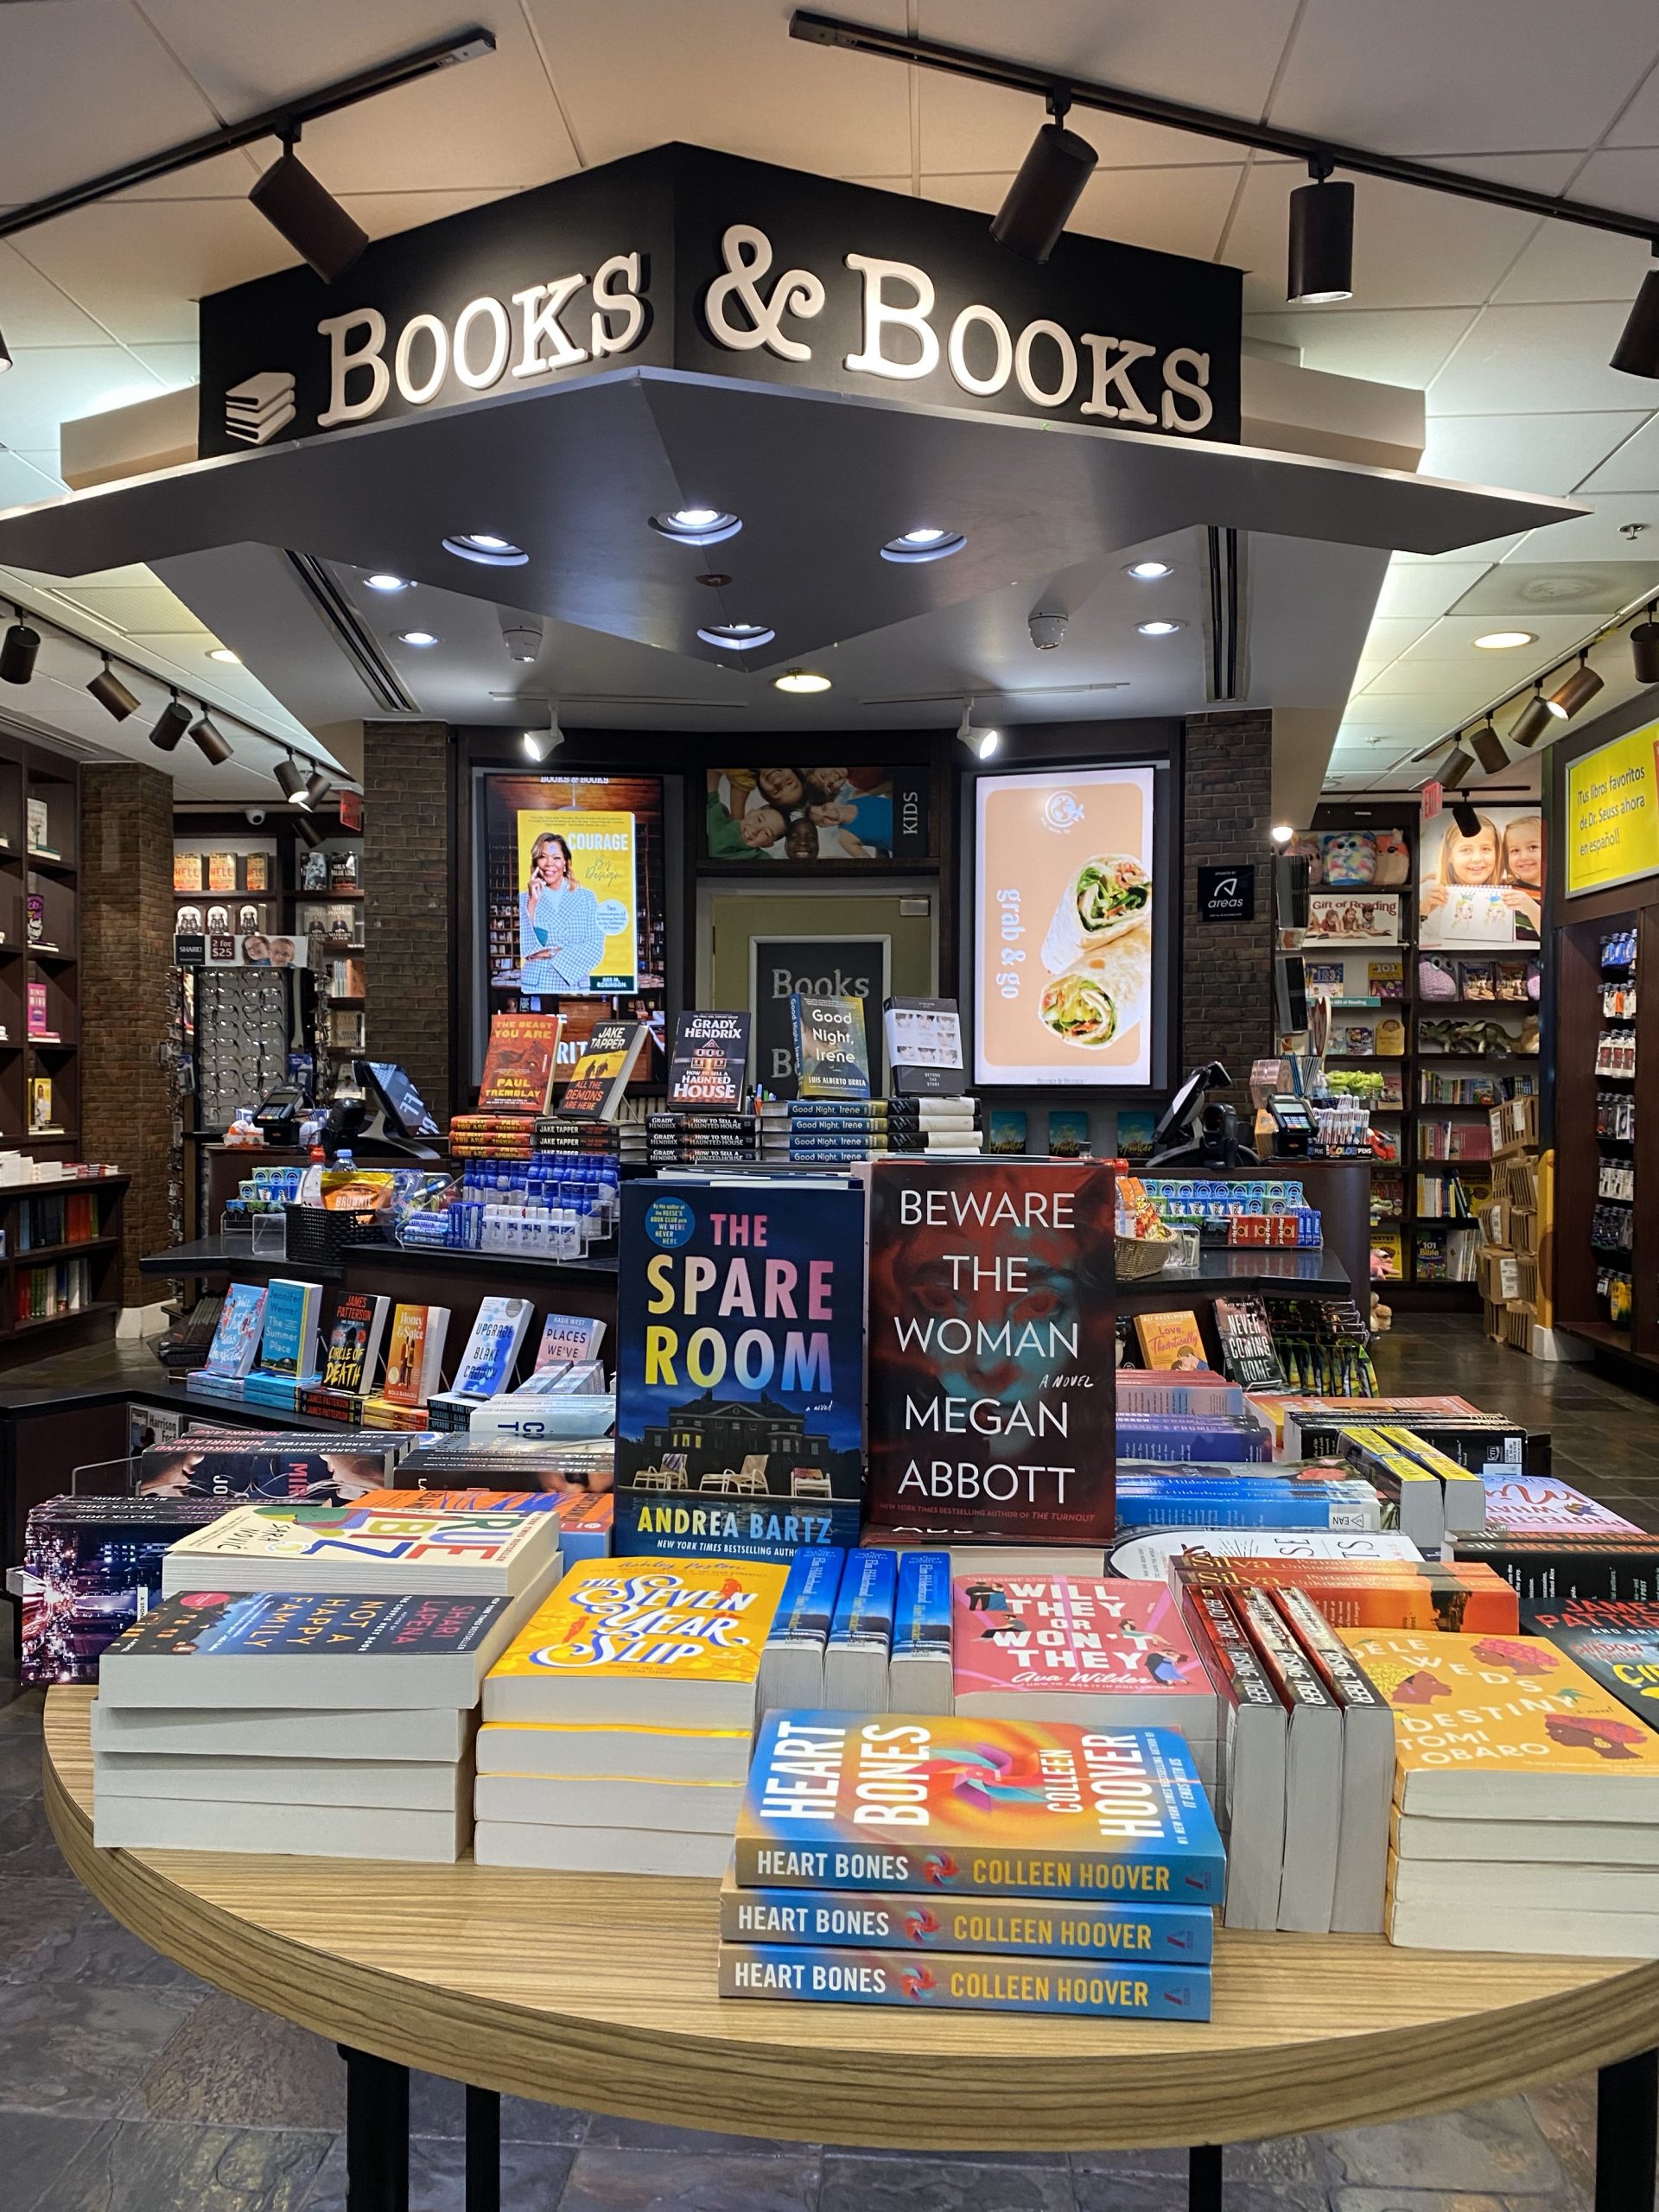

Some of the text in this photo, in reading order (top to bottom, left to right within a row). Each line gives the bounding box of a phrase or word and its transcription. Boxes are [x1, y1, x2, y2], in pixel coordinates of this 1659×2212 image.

[317, 223, 1213, 432] BOOKS & BOOKS
[1590, 781, 1607, 800] libros
[1609, 766, 1645, 791] favoritos
[903, 791, 918, 835] KIDS
[1580, 816, 1587, 831] de
[1599, 804, 1618, 823] Seuss
[1621, 795, 1645, 816] ahora
[568, 832, 629, 850] COURAGE
[1580, 828, 1620, 856] en español!
[1208, 899, 1243, 908] areas
[1312, 900, 1332, 909] Gift
[213, 947, 232, 957] $25
[996, 888, 1026, 999] grab & go
[772, 969, 869, 999] Books
[693, 1018, 737, 1030] GRADY
[812, 1009, 852, 1025] Good
[494, 1030, 551, 1039] YOU ARE
[598, 1027, 625, 1039] JAKE
[684, 1028, 742, 1039] HENDRIX
[813, 1028, 854, 1046] Night,
[589, 1038, 626, 1049] TAPPER
[816, 1049, 855, 1063] Irene
[497, 1078, 531, 1087] PAUL
[589, 1081, 603, 1090] THE
[682, 1075, 731, 1084] HAUNTED
[823, 1077, 847, 1085] ALBERTO
[565, 1089, 604, 1101] DEMONS
[674, 1084, 736, 1099] HOUSE
[564, 1101, 596, 1110] ARE HERE
[900, 1190, 1075, 1229] BEWARE
[710, 1213, 767, 1246] THE
[943, 1255, 1028, 1293] THE
[270, 1288, 302, 1302] Jennifer
[645, 1254, 835, 1320] SPARE
[270, 1303, 299, 1315] Weiner
[346, 1294, 366, 1306] JAMES
[269, 1315, 283, 1327] The
[337, 1306, 372, 1321] PATTERSON
[399, 1312, 423, 1331] Honey
[397, 1327, 423, 1341] & Spice
[475, 1322, 513, 1338] UPGRADE
[1227, 1313, 1262, 1335] NEVER
[266, 1329, 297, 1341] Summer
[546, 1328, 587, 1344] PLACES
[893, 1316, 1078, 1358] WOMAN
[1149, 1331, 1198, 1355] Theoretically
[270, 1342, 291, 1353] Place
[328, 1346, 365, 1361] CIRCLE OF
[474, 1346, 499, 1362] BLAKE
[548, 1345, 579, 1358] WE'VE
[1229, 1336, 1271, 1358] COMING
[645, 1325, 833, 1393] ROOM
[323, 1362, 361, 1387] DEATH
[463, 1365, 497, 1381] CROUCH
[1241, 1358, 1272, 1382] HOME
[1039, 1374, 1094, 1388] A NOVEL
[814, 1400, 833, 1412] novel
[906, 1394, 1068, 1438] MEGAN
[149, 1412, 176, 1431] Harrison
[898, 1459, 1076, 1503] ABBOTT
[897, 1503, 916, 1512] YORK
[939, 1507, 987, 1516] BESTSELLING
[987, 1510, 1018, 1519] AUTHOR
[1052, 1512, 1096, 1522] TURNOUT
[255, 1523, 291, 1541] SARA
[406, 1510, 531, 1560] TRUE
[637, 1506, 739, 1539] ANDREA
[750, 1514, 831, 1544] BARTZ
[217, 1528, 259, 1550] NOVIĆ
[301, 1520, 438, 1559] BIZ
[1193, 1555, 1274, 1569] Silva
[569, 1573, 759, 1611] SEVEN
[581, 1577, 626, 1588] THE
[1007, 1583, 1121, 1600] WILL
[1005, 1599, 1126, 1618] THEY
[242, 1597, 315, 1648] FAMILY
[285, 1599, 351, 1645] HAPPY
[325, 1600, 385, 1643] NOT A
[391, 1600, 448, 1644] LAPENA
[430, 1605, 476, 1638] SHARI
[584, 1603, 750, 1647] YEAR
[1049, 1618, 1092, 1630] OR
[1203, 1599, 1239, 1640] BRAD THOR
[529, 1630, 705, 1668] SLIP
[993, 1630, 1154, 1651] WON'T
[1007, 1649, 1143, 1669] THEY
[1011, 1671, 1154, 1685] Ava Wilder
[1227, 1649, 1273, 1703] RISING TIGER
[1402, 1656, 1544, 1693] WEDS
[1401, 1695, 1578, 1733] DESTINY
[1395, 1730, 1491, 1751] TOMI
[1421, 1743, 1550, 1765] OBARO
[760, 1720, 847, 1821] HEART
[853, 1724, 932, 1827] BONES
[1039, 1747, 1084, 1813] COLLEEN
[1081, 1733, 1165, 1839] HOOVER
[1168, 1758, 1198, 1809] IT ENDS WITH US
[758, 1851, 1170, 1892] HEART BONES COLLEEN HOOVER
